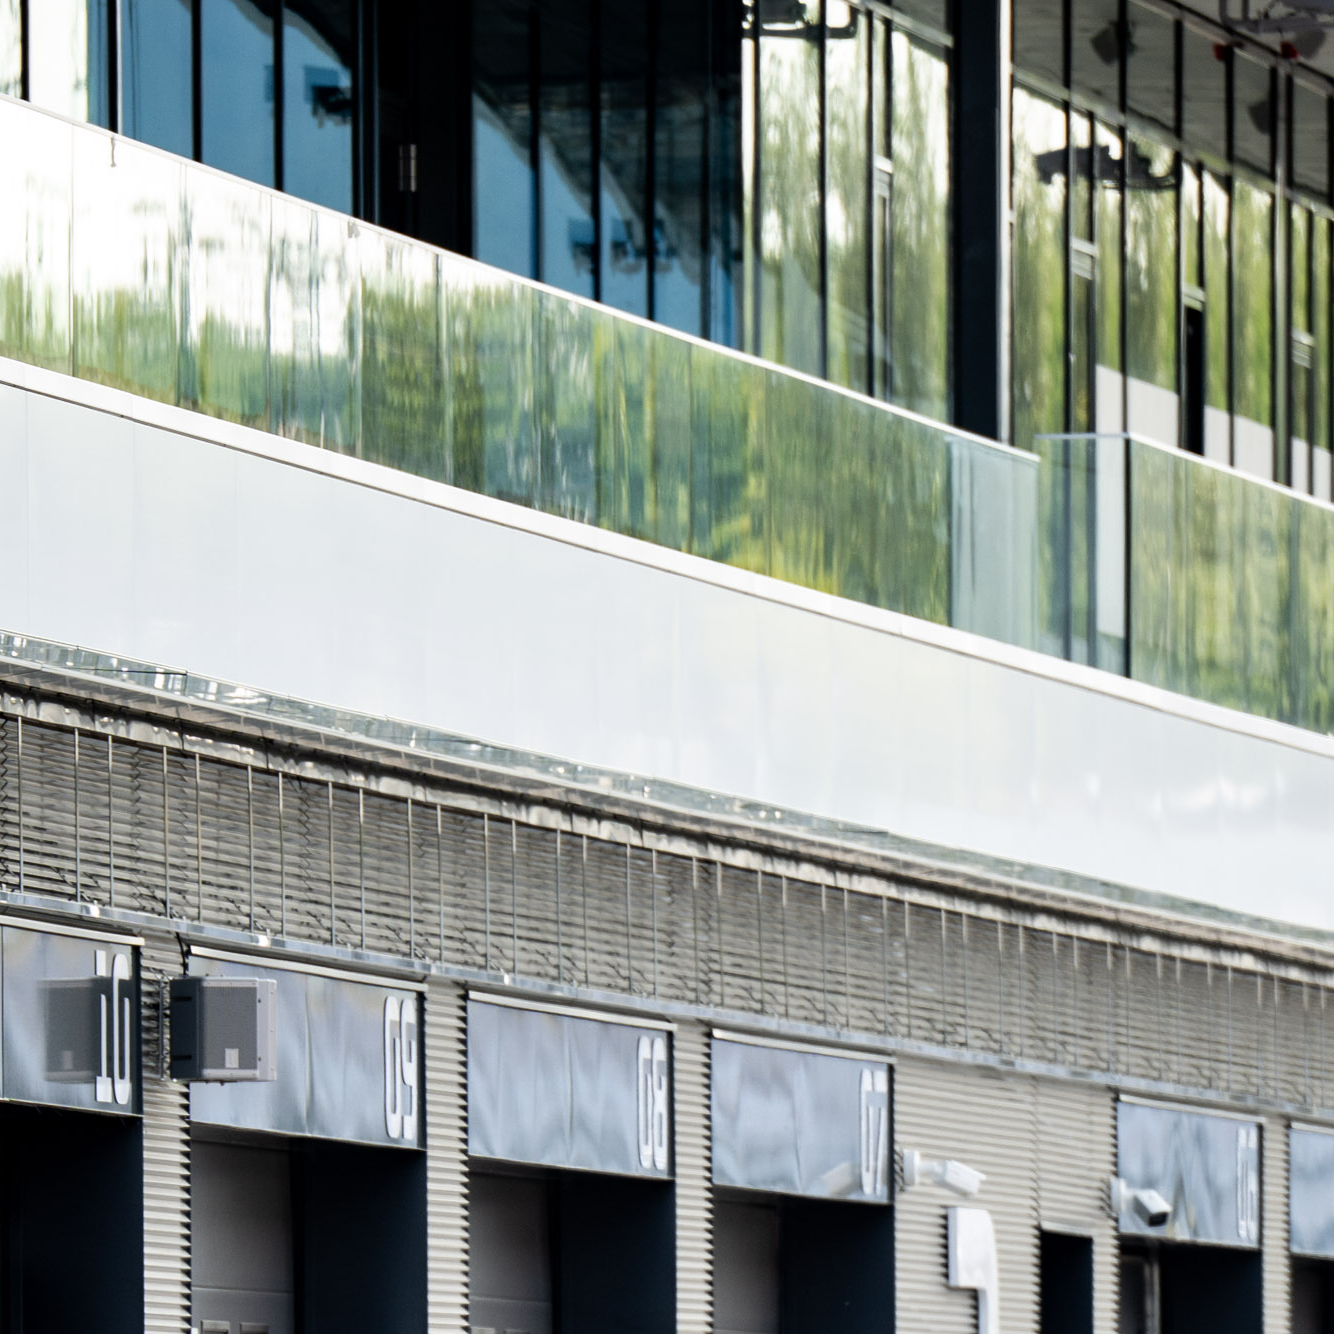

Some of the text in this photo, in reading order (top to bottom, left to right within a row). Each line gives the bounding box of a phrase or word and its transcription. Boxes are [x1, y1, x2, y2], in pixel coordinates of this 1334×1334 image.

[94, 949, 132, 1105] 10
[383, 995, 418, 1140] 09
[637, 1036, 668, 1172] 08
[860, 1068, 887, 1195] 07
